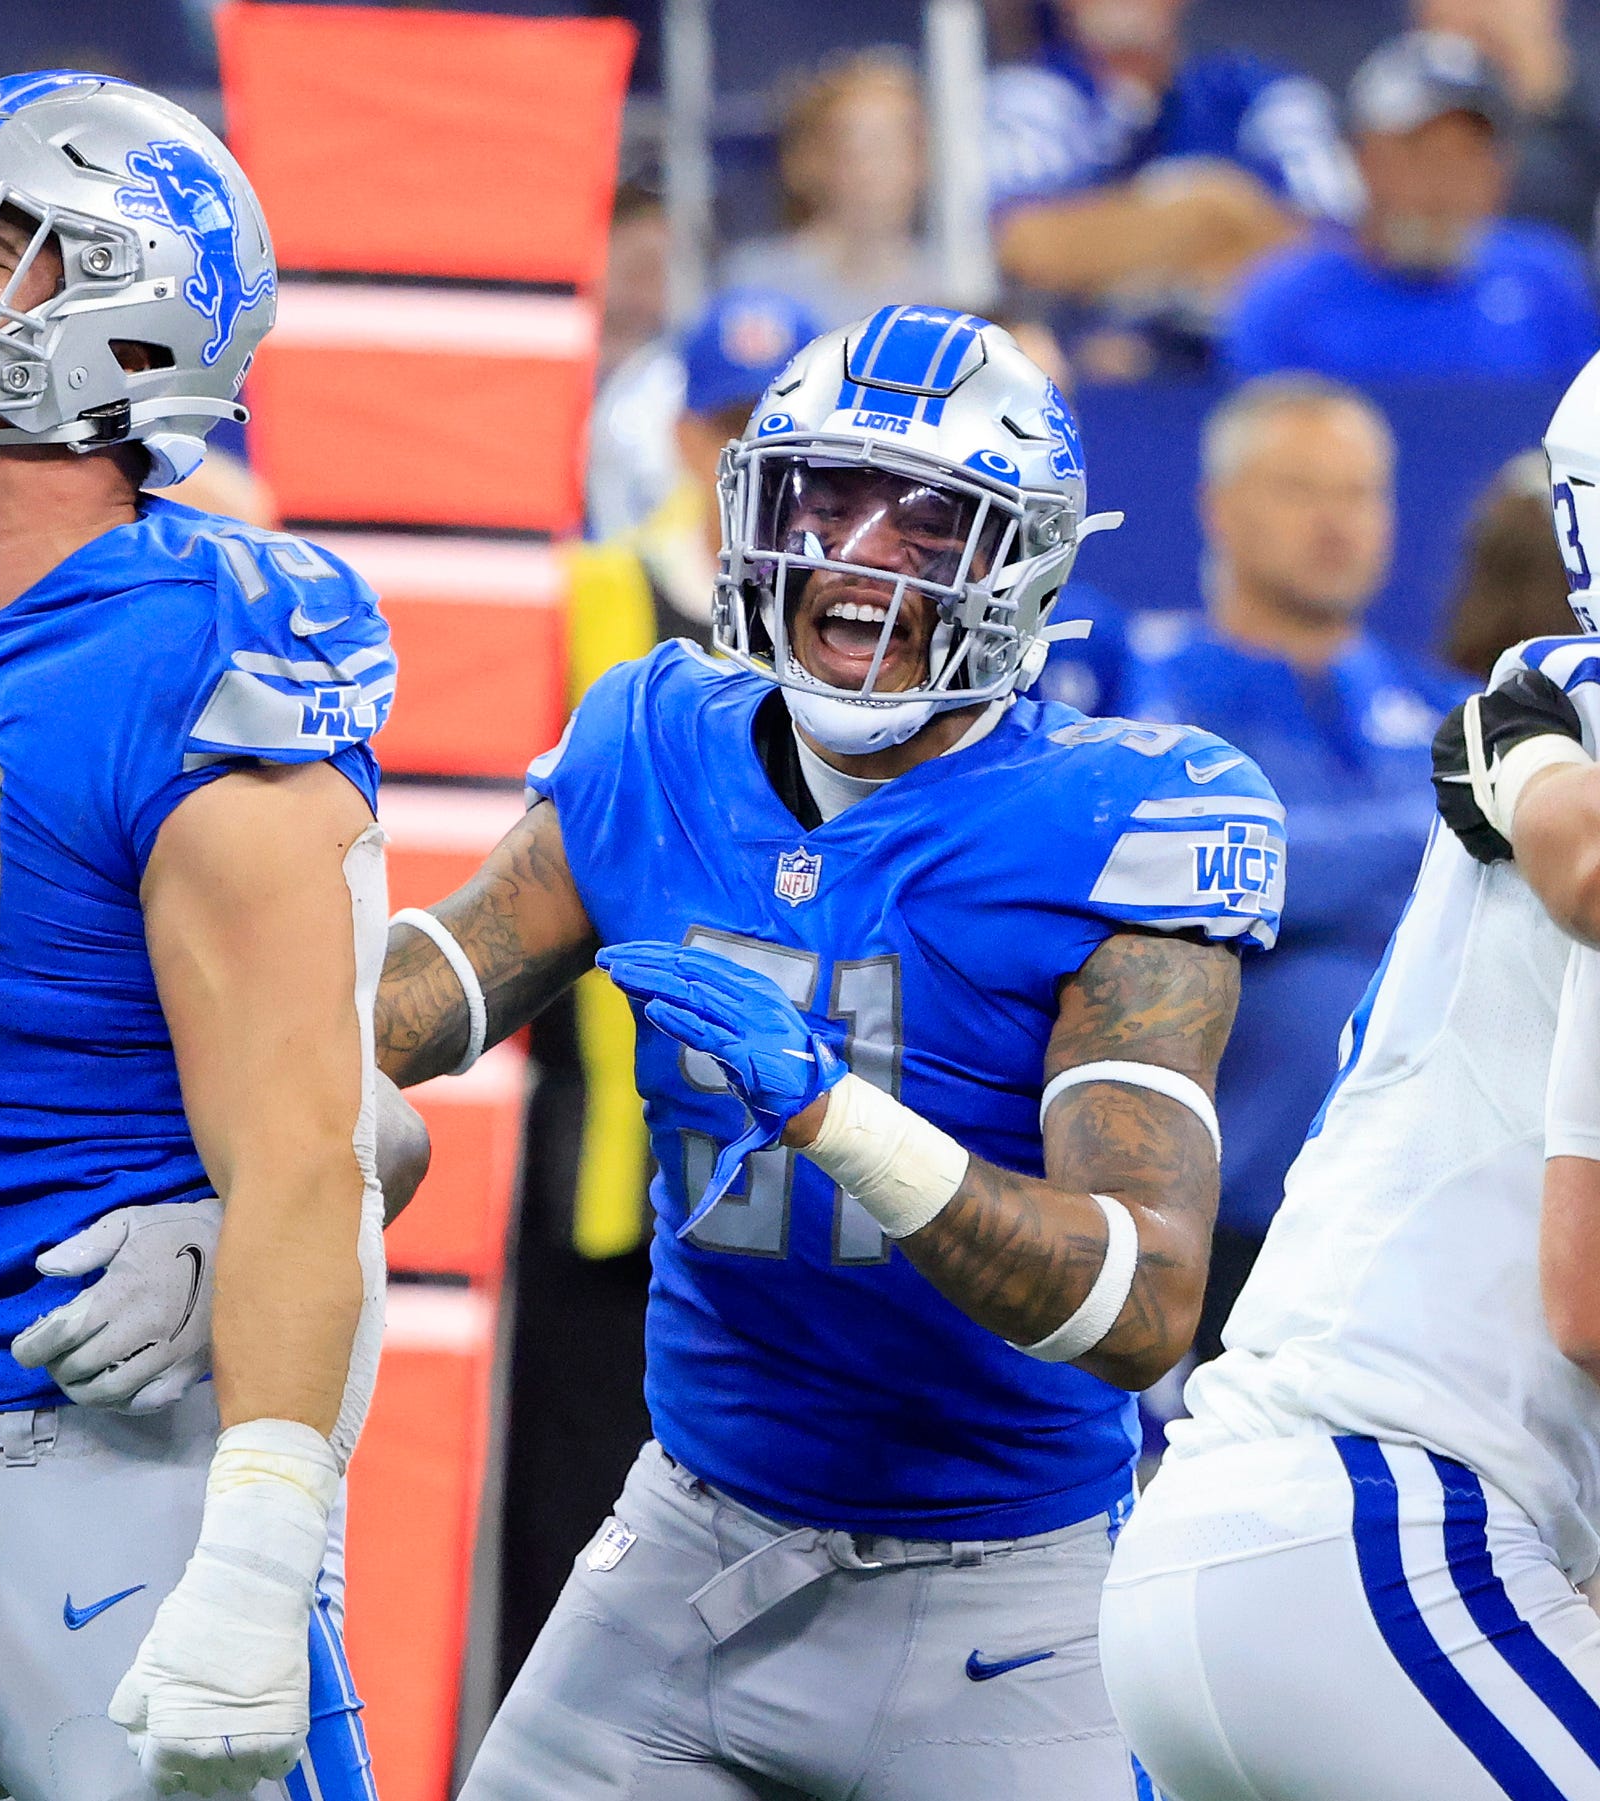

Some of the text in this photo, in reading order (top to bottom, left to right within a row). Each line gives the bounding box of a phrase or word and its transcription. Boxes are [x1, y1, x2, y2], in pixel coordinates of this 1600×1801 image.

[851, 411, 912, 435] LIONS
[1188, 842, 1281, 899] WCF
[780, 873, 811, 896] NFL
